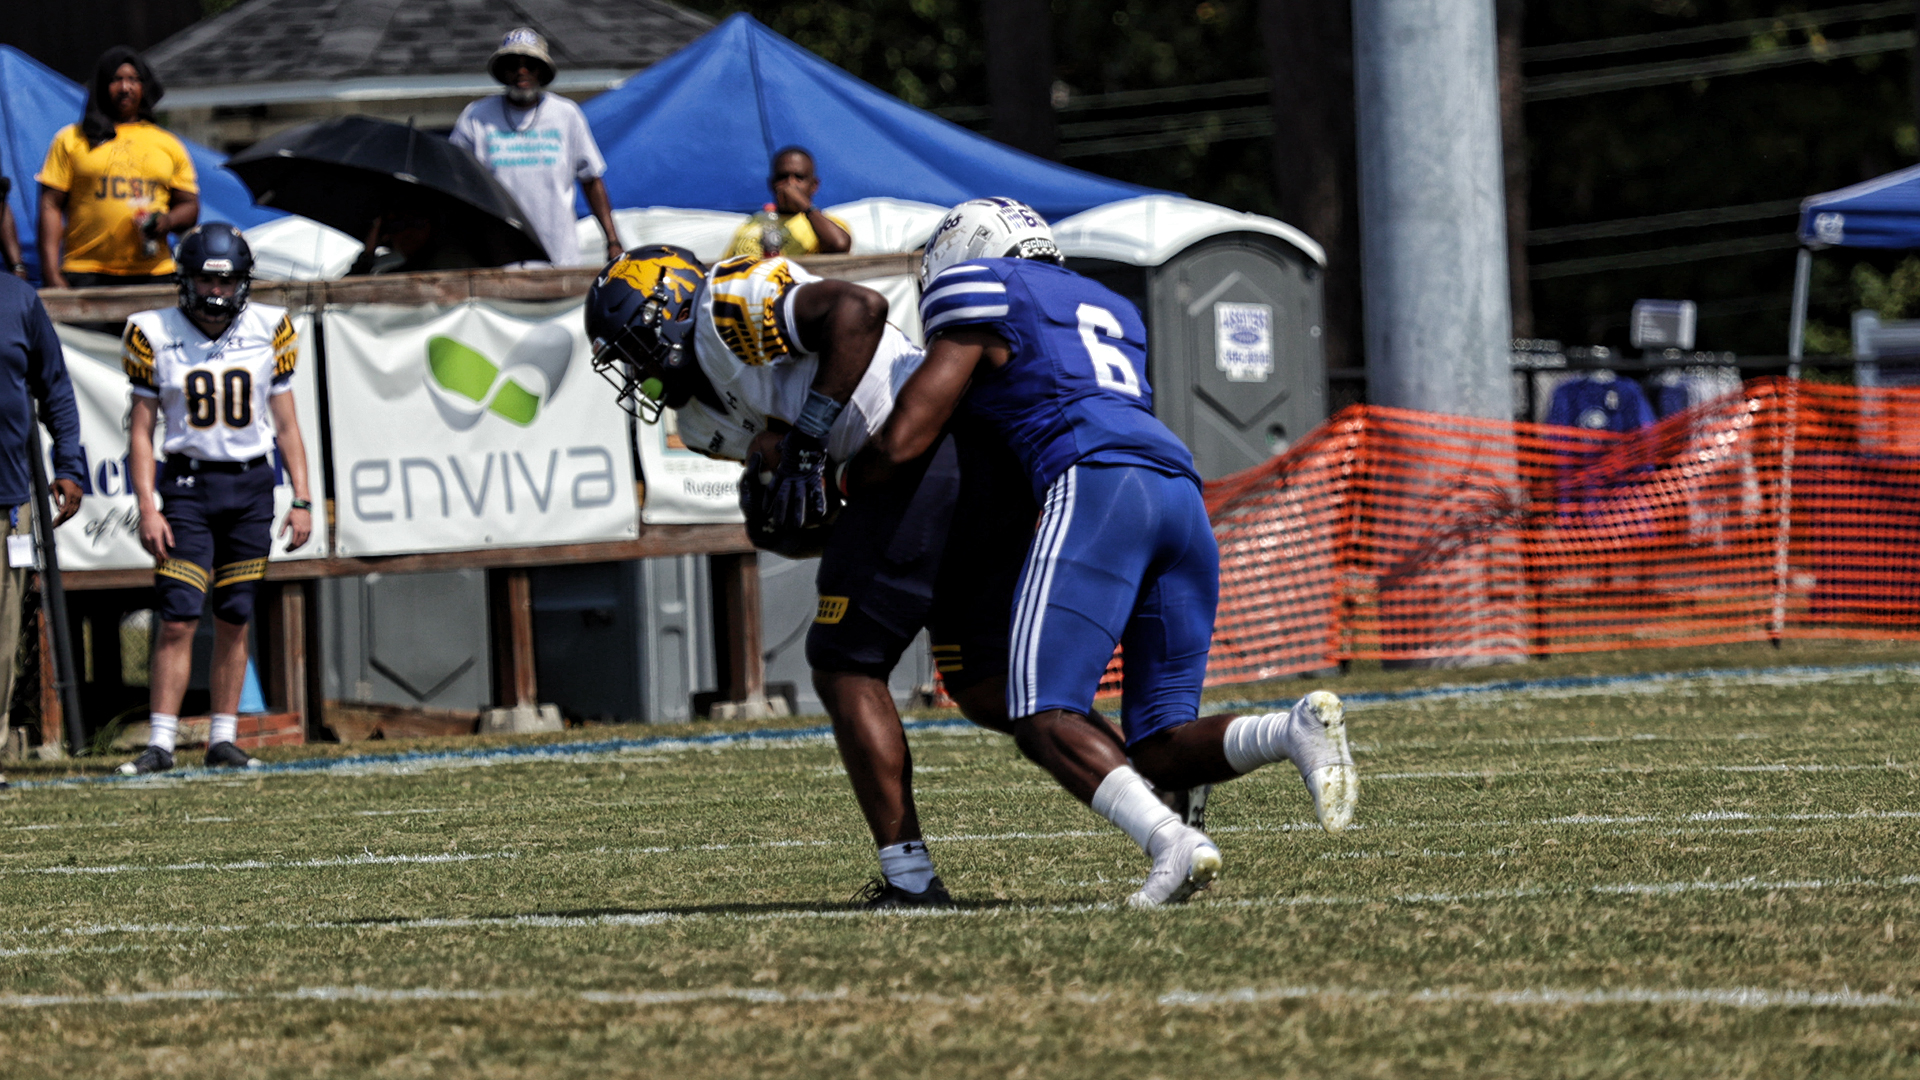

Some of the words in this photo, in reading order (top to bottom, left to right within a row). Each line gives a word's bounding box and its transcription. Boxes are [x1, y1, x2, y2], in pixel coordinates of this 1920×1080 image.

[1018, 208, 1037, 228] 6
[1075, 302, 1141, 397] 6
[185, 367, 252, 430] 80
[350, 445, 616, 523] enviva
